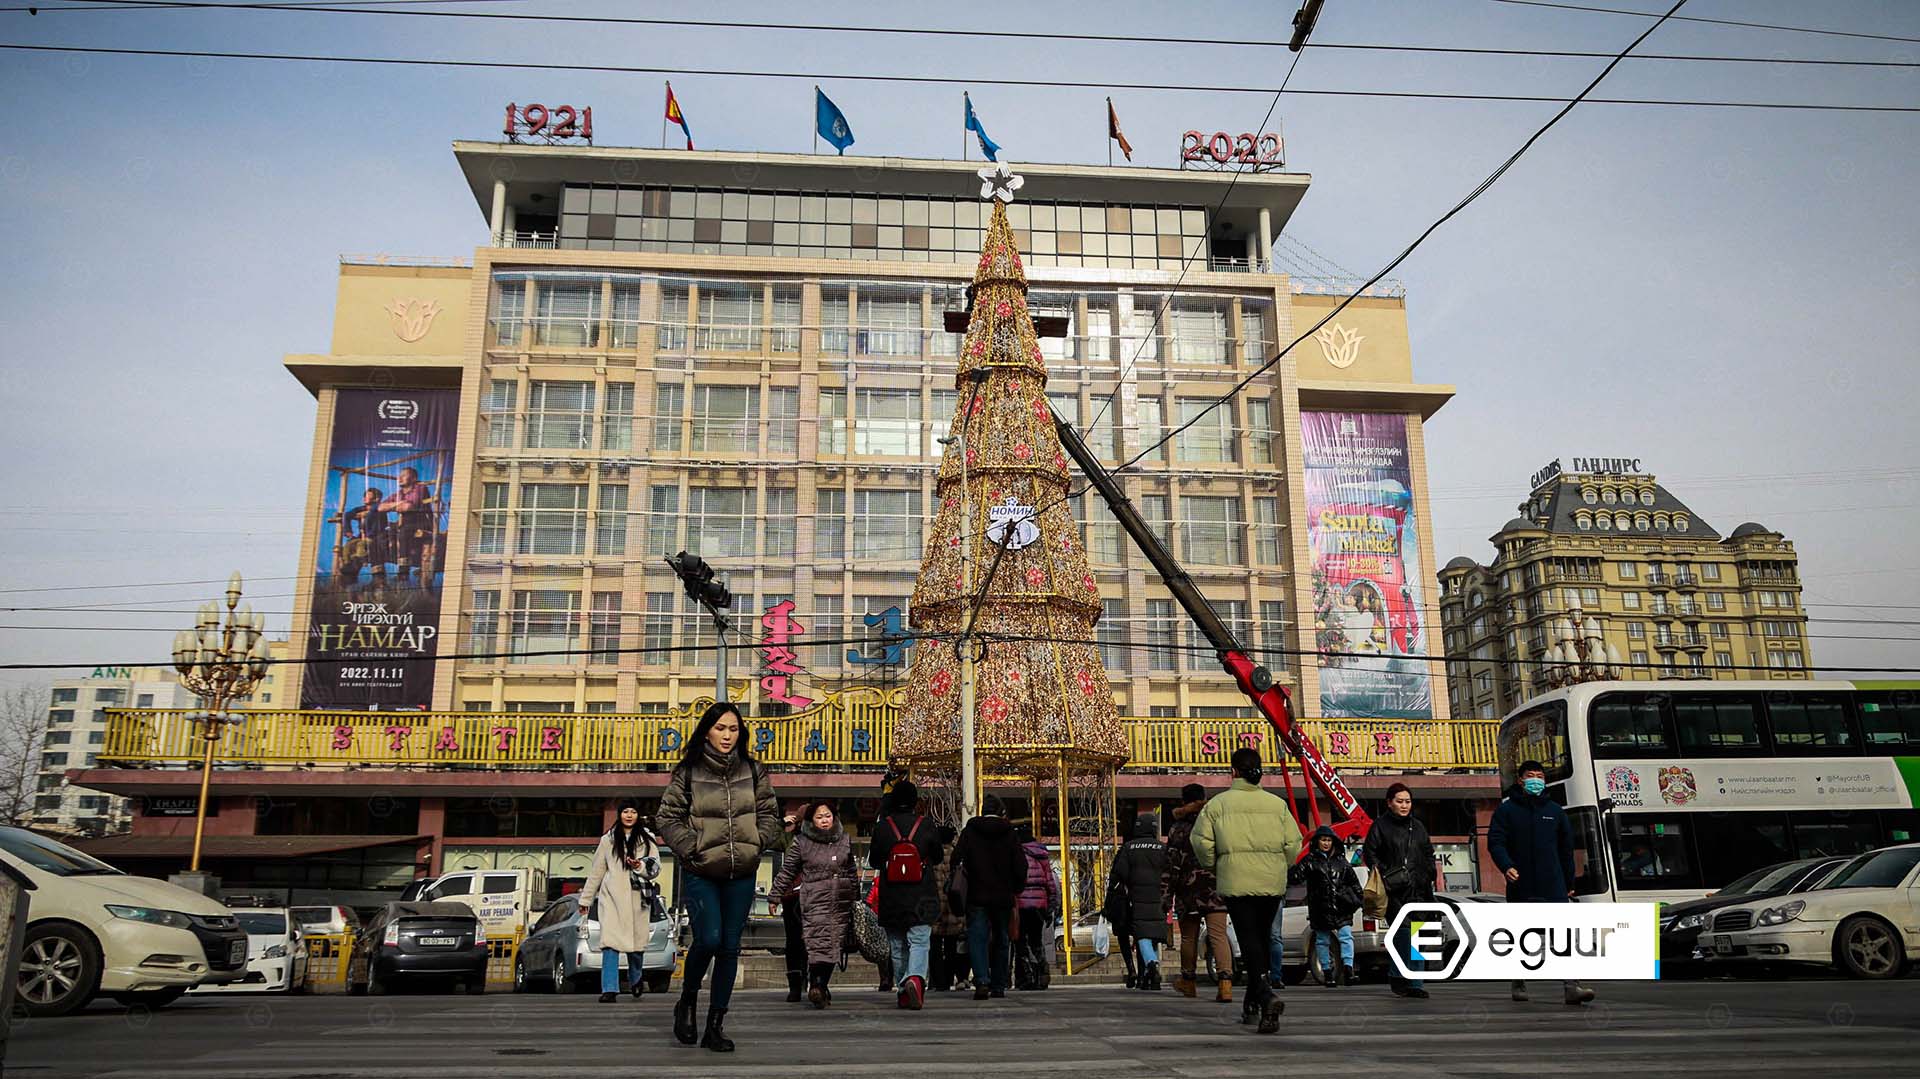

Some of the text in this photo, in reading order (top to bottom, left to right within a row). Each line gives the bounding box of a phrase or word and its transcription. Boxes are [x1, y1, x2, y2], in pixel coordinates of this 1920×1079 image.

[503, 102, 593, 138] 1921
[1183, 130, 1282, 165] 2022
[1573, 457, 1642, 474] ГАНДИРС
[991, 506, 1033, 516] НОМИН
[341, 601, 388, 621] ЭРГЭЖ
[316, 623, 436, 653] НАМАР
[340, 667, 404, 679] 2022.11.11
[332, 726, 563, 752] STATE
